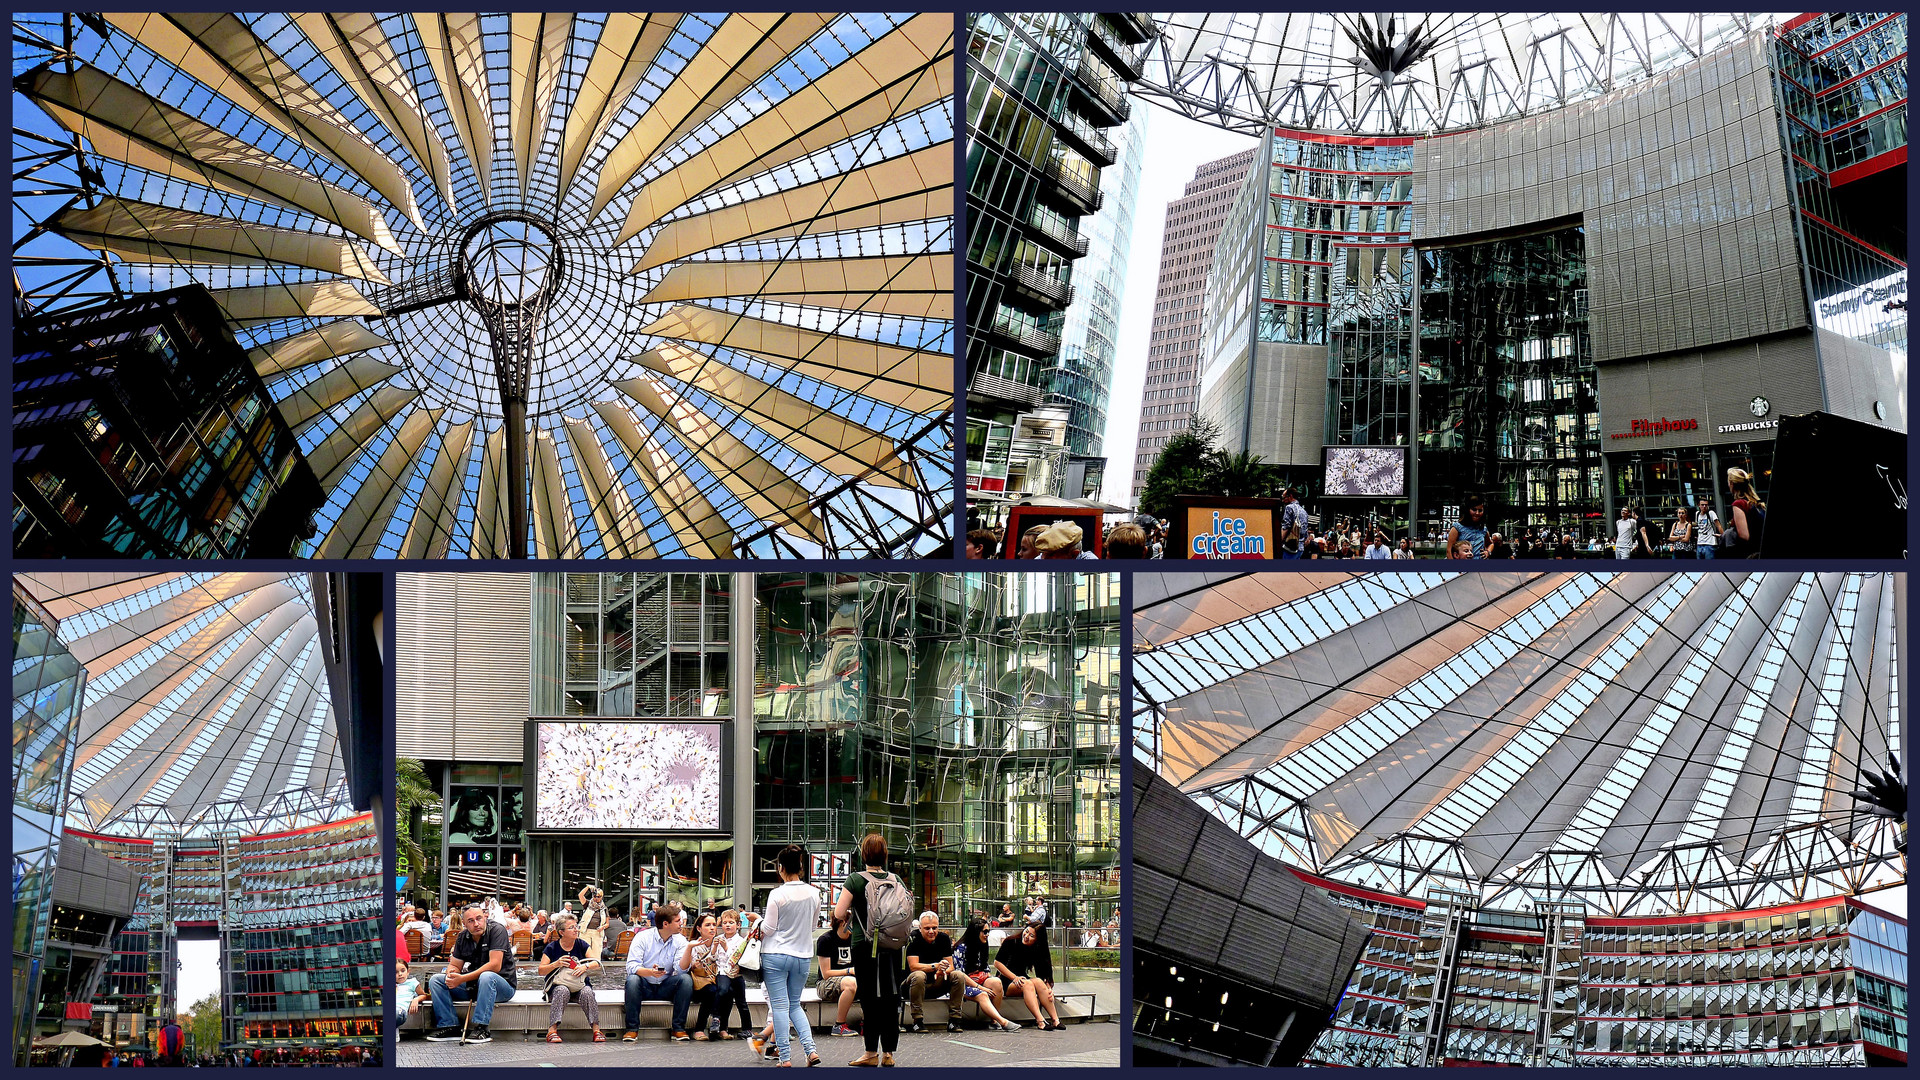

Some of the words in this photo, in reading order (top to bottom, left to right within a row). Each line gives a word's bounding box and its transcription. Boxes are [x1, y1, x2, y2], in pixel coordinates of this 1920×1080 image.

[1631, 417, 1698, 432] Filmhaus
[1718, 420, 1772, 433] STARBUCKS
[1772, 420, 1778, 428] C
[1213, 511, 1246, 536] ice
[1193, 535, 1265, 554] cream
